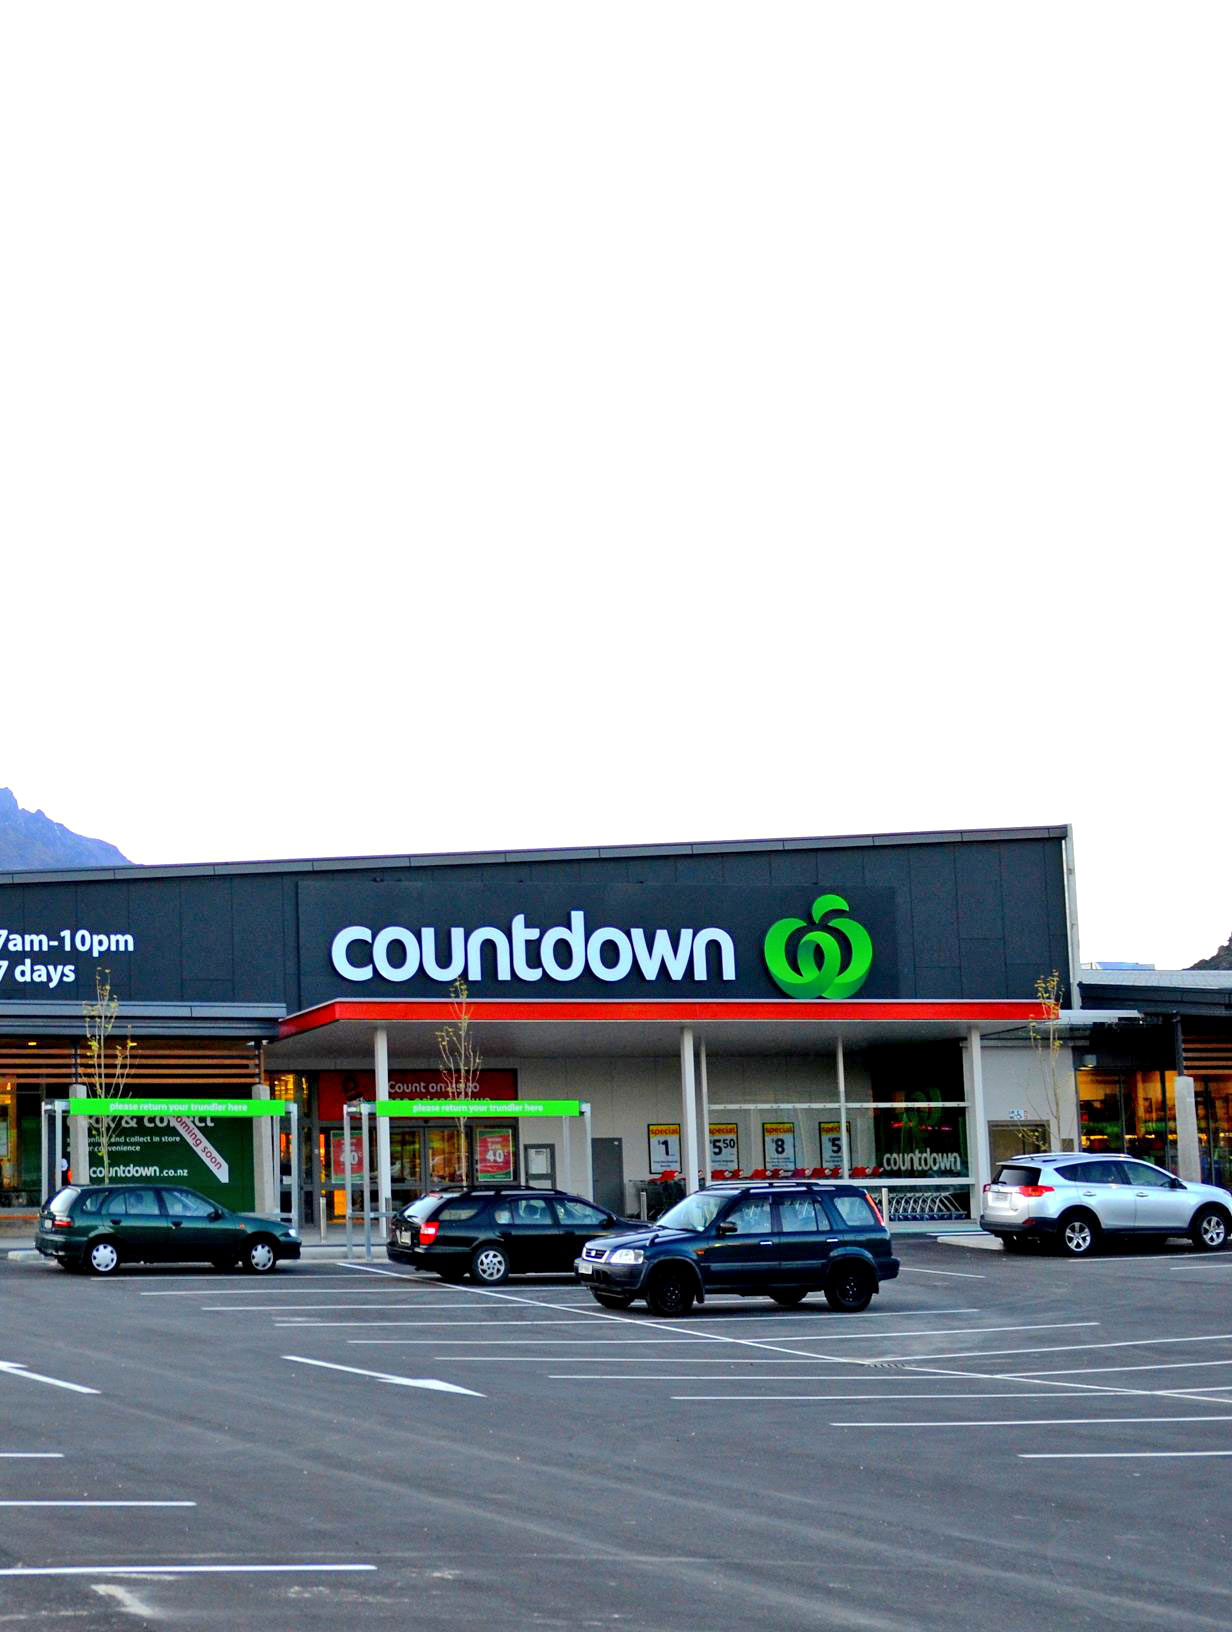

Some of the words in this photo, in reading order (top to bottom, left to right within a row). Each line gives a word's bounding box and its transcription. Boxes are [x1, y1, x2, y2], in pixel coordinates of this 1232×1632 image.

[331, 910, 736, 982] countdown
[14, 959, 75, 988] days
[388, 1082, 426, 1093] Count
[429, 1083, 445, 1093] on
[110, 1102, 138, 1112] please
[139, 1103, 167, 1111] return
[169, 1103, 188, 1112] your
[190, 1102, 226, 1112] trundler
[228, 1103, 247, 1112] here
[413, 1104, 439, 1114] please
[441, 1104, 467, 1112] return
[469, 1105, 488, 1113] your
[490, 1104, 522, 1112] trundler
[524, 1104, 544, 1112] here
[650, 1127, 679, 1136] special
[765, 1127, 794, 1135] special
[175, 1116, 203, 1148] oming
[201, 1146, 223, 1170] soon
[883, 1147, 961, 1171] countdown
